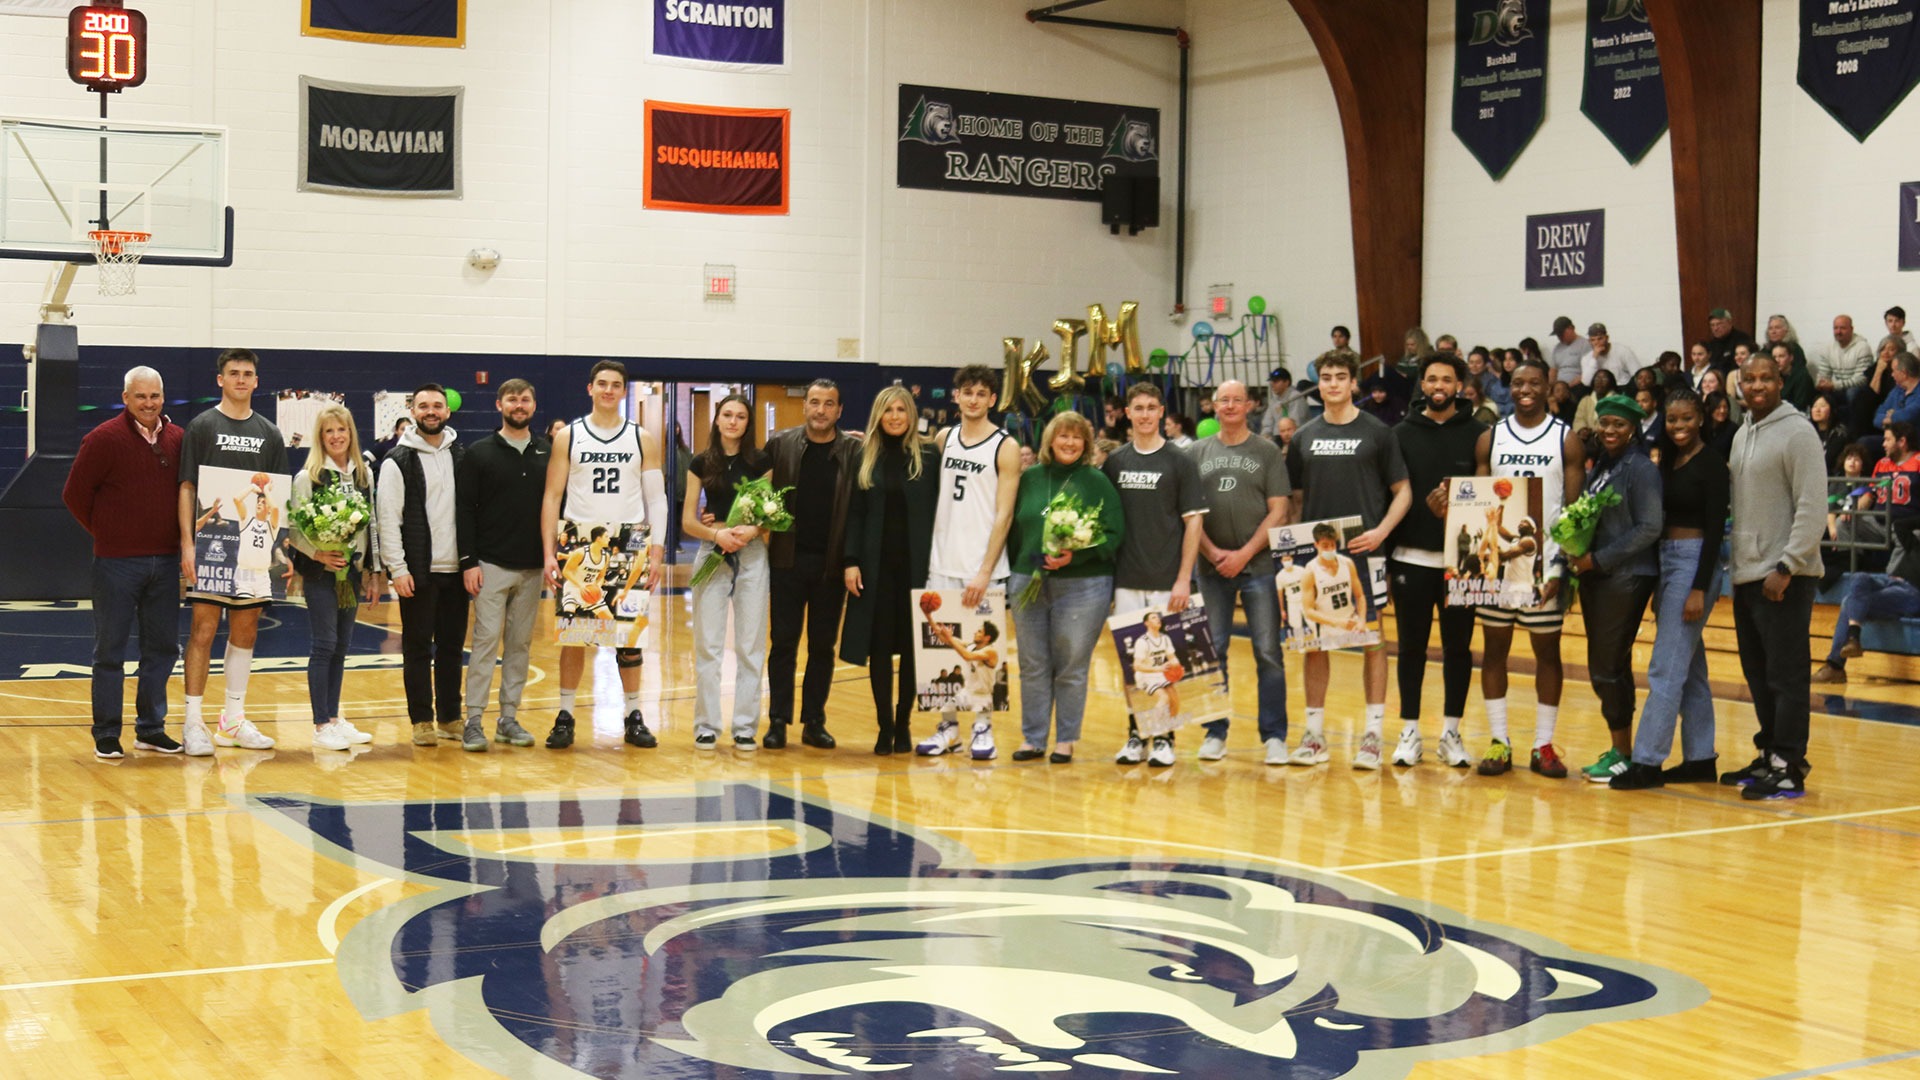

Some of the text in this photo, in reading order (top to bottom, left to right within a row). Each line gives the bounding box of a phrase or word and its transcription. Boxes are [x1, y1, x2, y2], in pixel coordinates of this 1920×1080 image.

[665, 0, 774, 29] SCRANTON
[1828, 0, 1857, 15] Men's
[85, 12, 129, 33] 20:00
[80, 31, 137, 80] 30
[1486, 53, 1517, 67] Baseball
[1836, 58, 1859, 75] 2008
[1613, 86, 1632, 100] 2022
[320, 123, 445, 154] MORAVIAN
[958, 115, 1104, 147] HOME OF THE
[657, 145, 780, 170] SUSQUEHANNA
[1537, 222, 1592, 250] DREW
[1540, 251, 1586, 278] FANS
[216, 433, 266, 447] DREW
[1310, 439, 1362, 451] DREW
[221, 445, 261, 454] BASKETBALL
[579, 452, 634, 465] DREW
[944, 457, 988, 475] DREW
[1200, 455, 1261, 476] DREW
[1498, 454, 1554, 467] DREW
[593, 467, 620, 494] 22
[1118, 471, 1163, 485] DREW
[1218, 477, 1237, 492] D
[953, 475, 968, 502] 5
[252, 535, 265, 549] 23
[197, 578, 232, 593] KANE
[1331, 591, 1349, 610] 55
